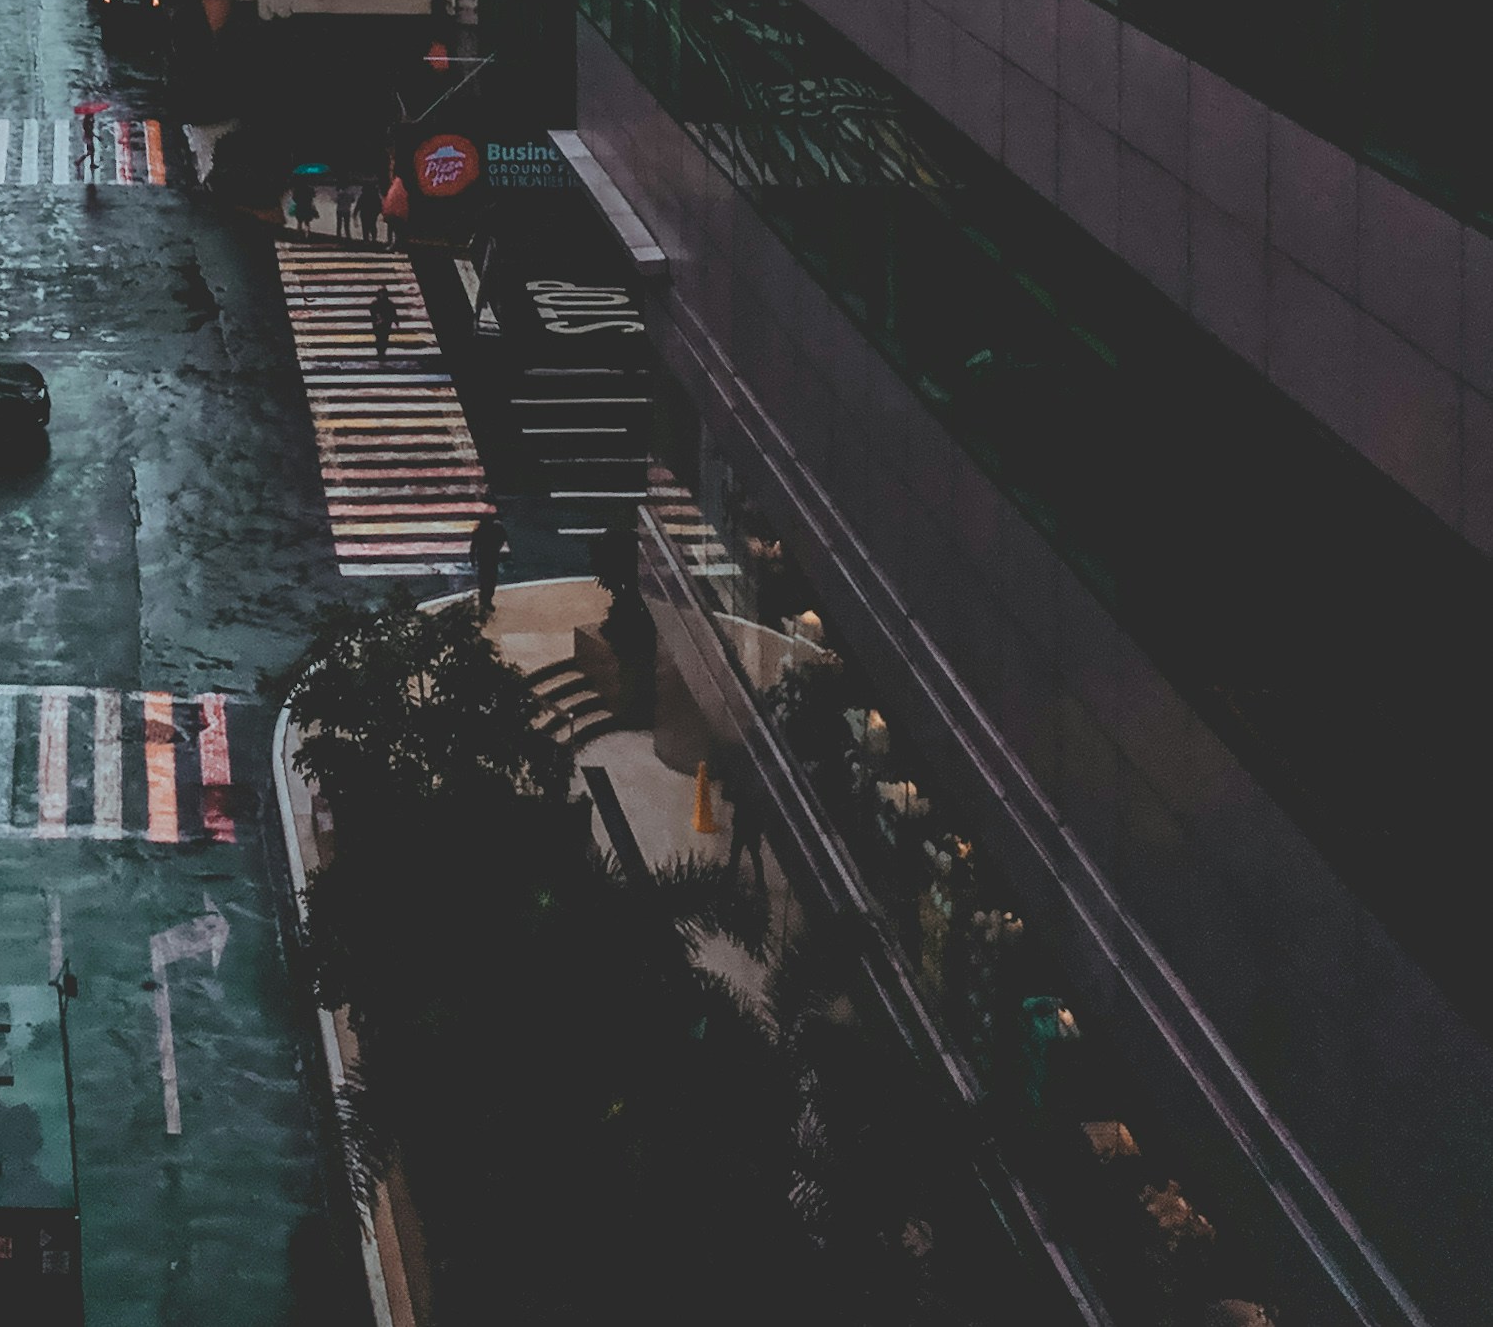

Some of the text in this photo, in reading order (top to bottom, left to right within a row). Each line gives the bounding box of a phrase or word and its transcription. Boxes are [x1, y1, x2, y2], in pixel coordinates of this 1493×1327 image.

[425, 159, 464, 177] Pizza
[488, 163, 552, 175] GROUND
[432, 169, 461, 187] Hut
[525, 280, 645, 334] STOP
